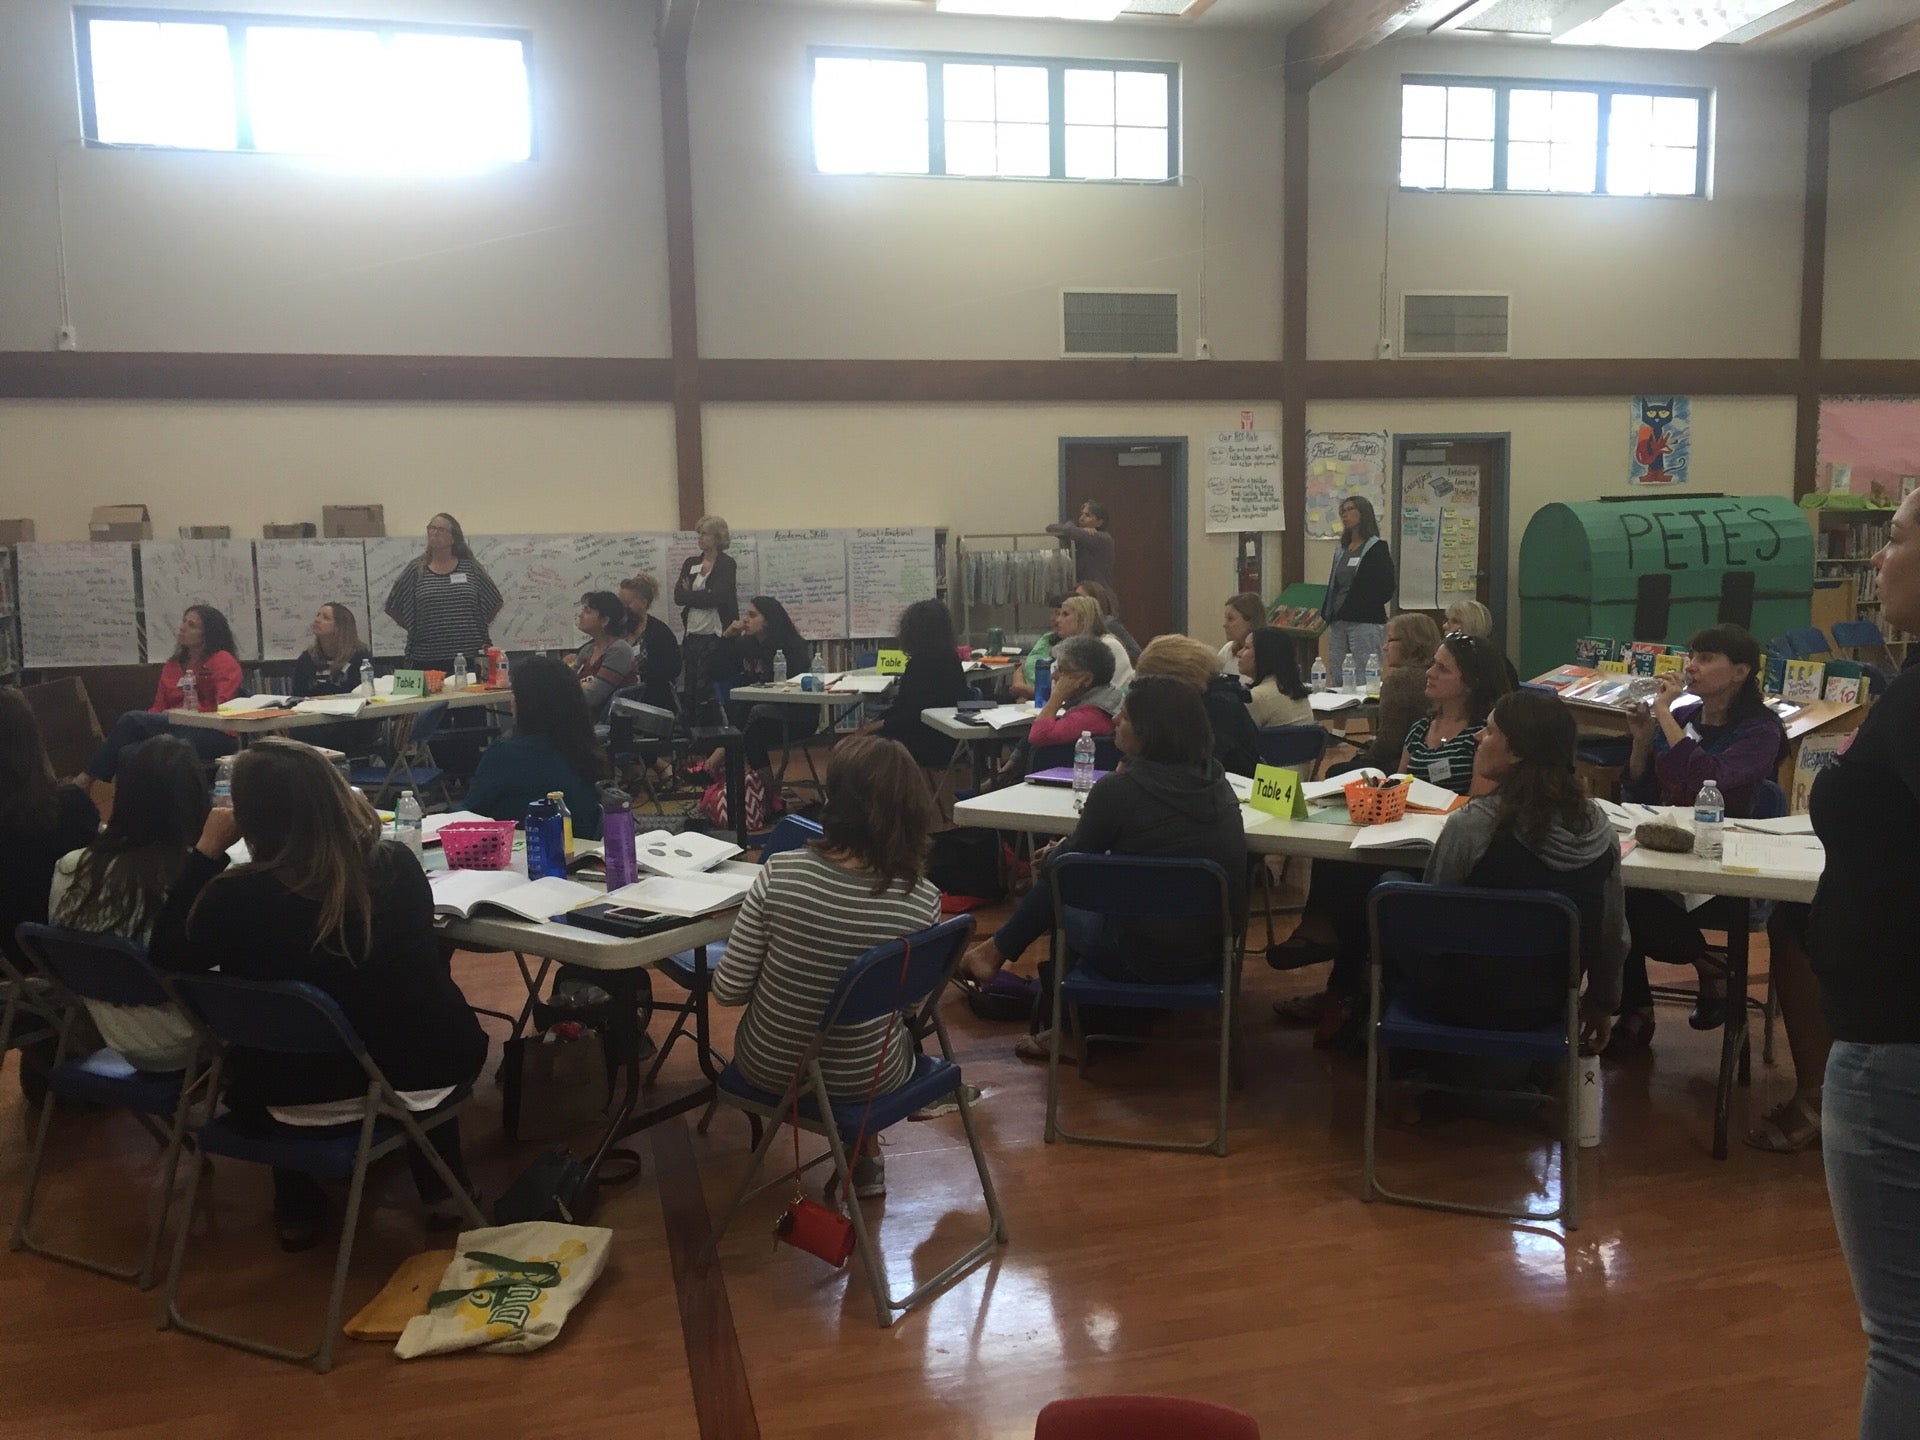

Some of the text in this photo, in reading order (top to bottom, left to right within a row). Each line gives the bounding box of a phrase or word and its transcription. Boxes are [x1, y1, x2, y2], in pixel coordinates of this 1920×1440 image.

[1619, 503, 1781, 570] PETE'S
[880, 656, 902, 667] Table
[396, 676, 421, 689] Table 1
[1257, 778, 1292, 804] Table 4
